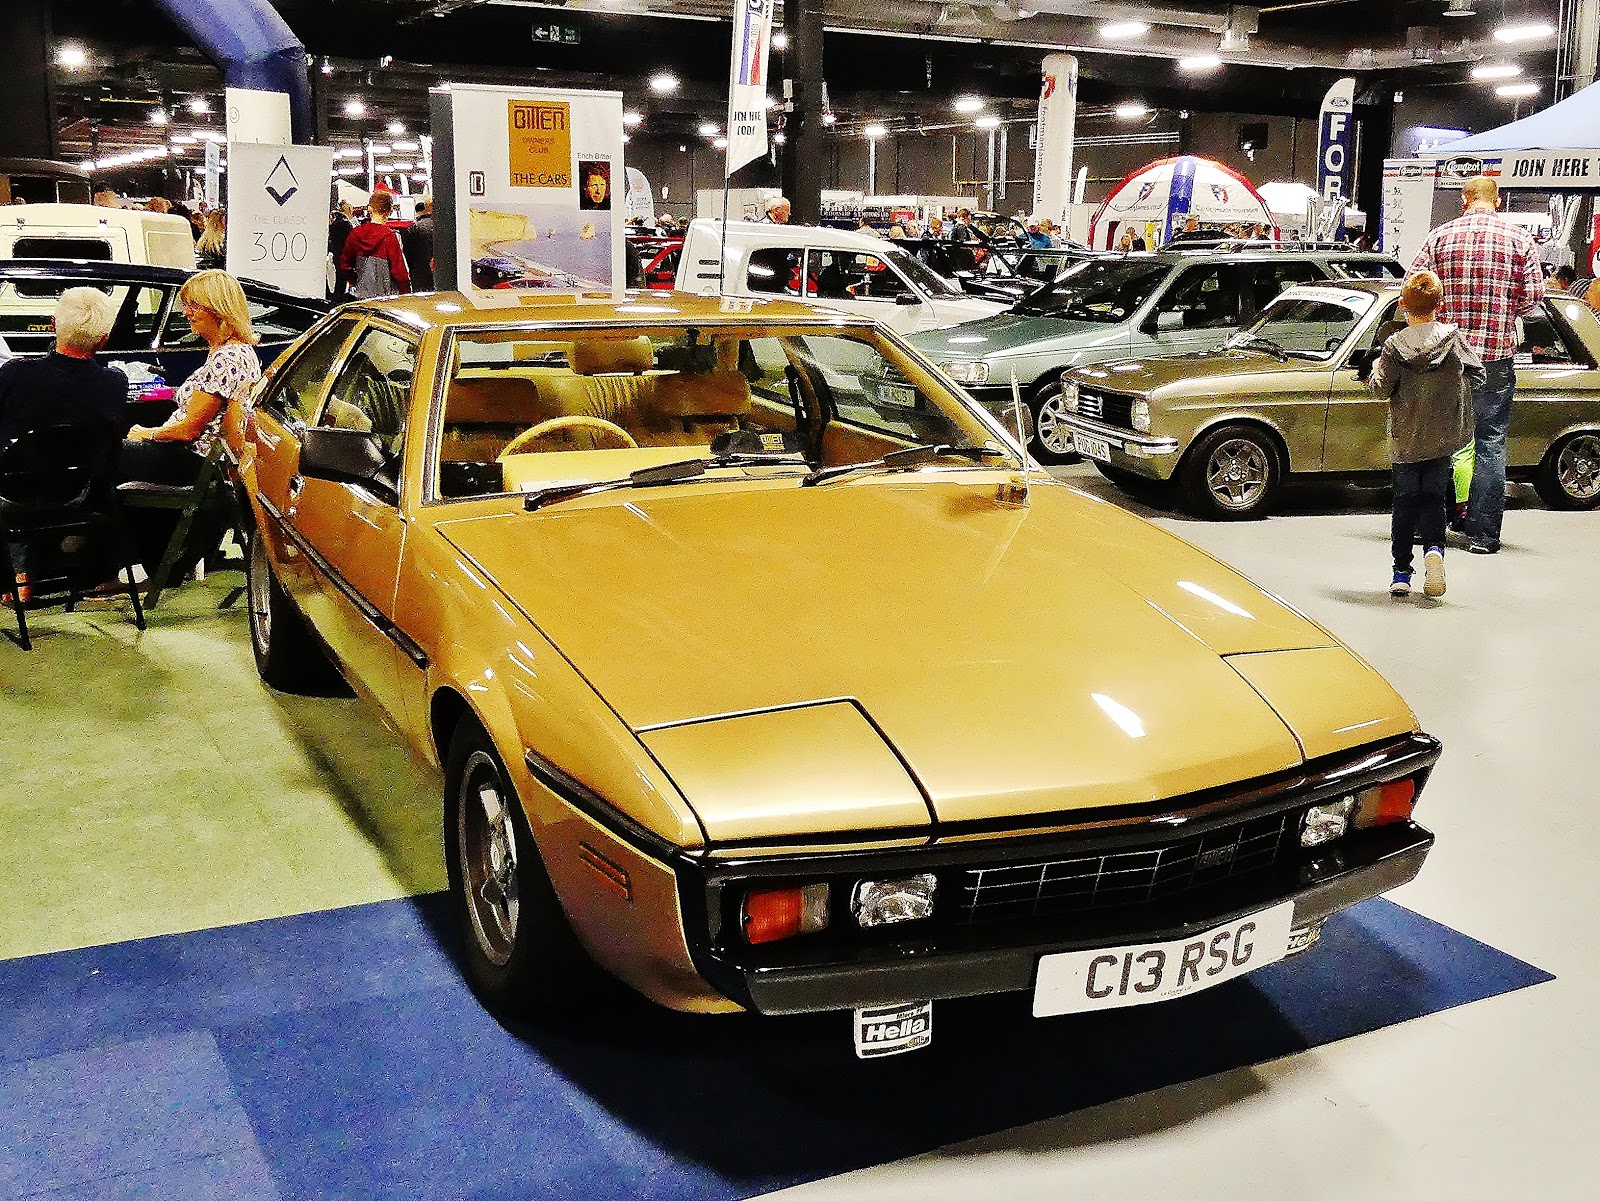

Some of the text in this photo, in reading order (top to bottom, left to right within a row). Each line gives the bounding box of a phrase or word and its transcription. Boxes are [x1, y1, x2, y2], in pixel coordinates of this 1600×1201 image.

[512, 172, 567, 186] THE CARS
[1511, 158, 1546, 177] JOIN
[1551, 158, 1590, 177] HERE
[251, 231, 308, 262] 300
[1085, 921, 1257, 999] C13 RSG
[865, 1018, 926, 1042] Hella
